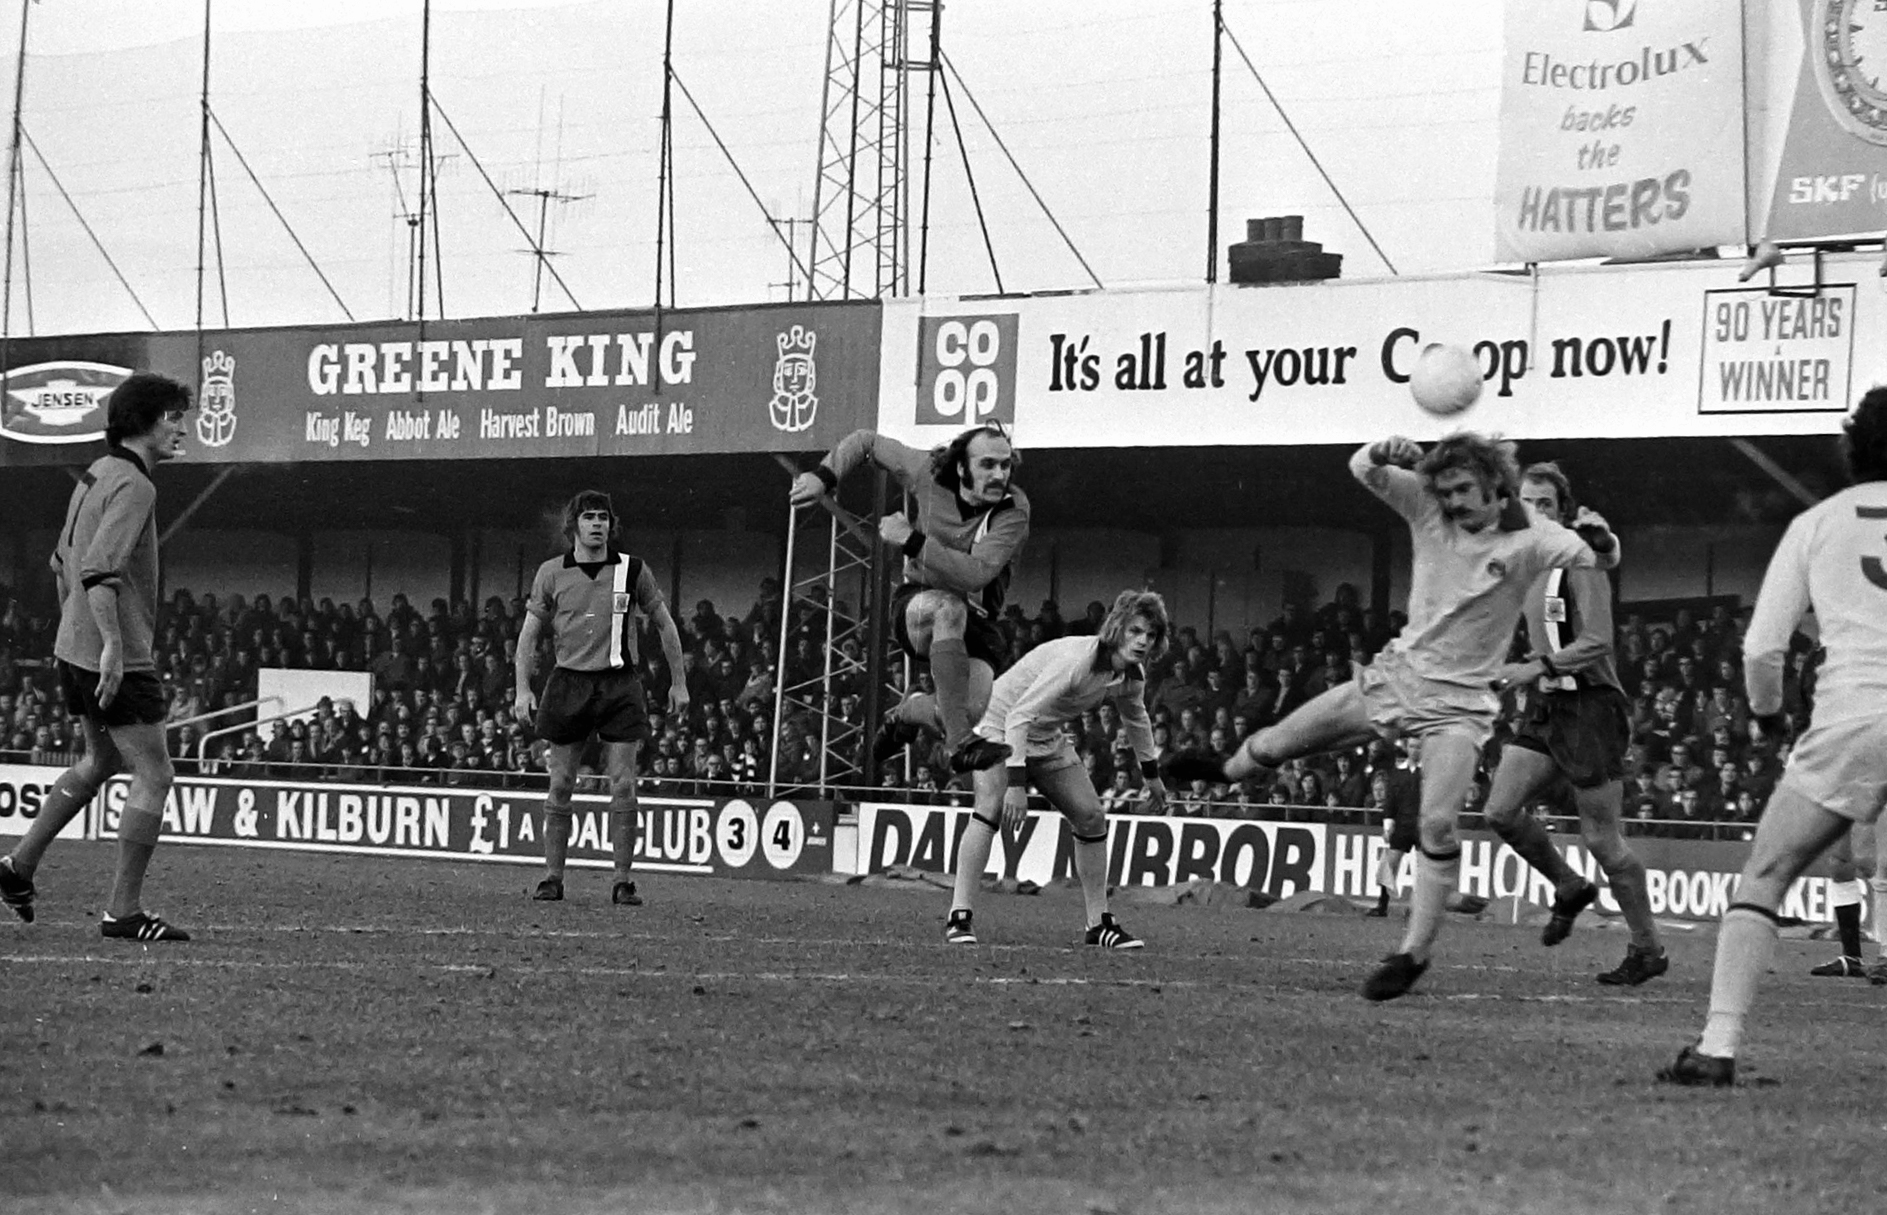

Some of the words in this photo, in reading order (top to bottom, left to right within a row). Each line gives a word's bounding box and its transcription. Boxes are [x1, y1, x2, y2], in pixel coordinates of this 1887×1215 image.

[1523, 36, 1710, 90] Electrolux
[1561, 104, 1636, 132] backs
[1578, 139, 1621, 170] the
[1518, 169, 1692, 233] HATTERS
[1788, 173, 1866, 204] SKF
[1716, 301, 1750, 342] 90
[1761, 297, 1843, 340] YEARS
[307, 337, 523, 396] GREENE
[545, 330, 696, 389] KING
[1048, 333, 1100, 392] It's
[1114, 332, 1167, 391] all
[1183, 339, 1227, 389] at
[1245, 345, 1357, 402] your
[1550, 319, 1671, 378] now!
[1719, 359, 1830, 401] WINNER
[31, 392, 95, 407] JENSEN
[306, 411, 340, 447] King
[344, 411, 371, 447] Keg
[386, 410, 430, 440] Abbot
[436, 408, 460, 439] Ale
[480, 407, 540, 438] Harvest
[546, 406, 595, 437] Brown
[616, 403, 660, 435] Audit
[666, 403, 693, 434] Ale
[0, 782, 52, 819] OS
[107, 782, 218, 834] SAW
[234, 788, 259, 838] &
[277, 791, 450, 848] KILBURN
[518, 812, 534, 842] A
[727, 817, 745, 850] 3
[773, 820, 791, 851] 4
[868, 808, 1040, 880] DAIY
